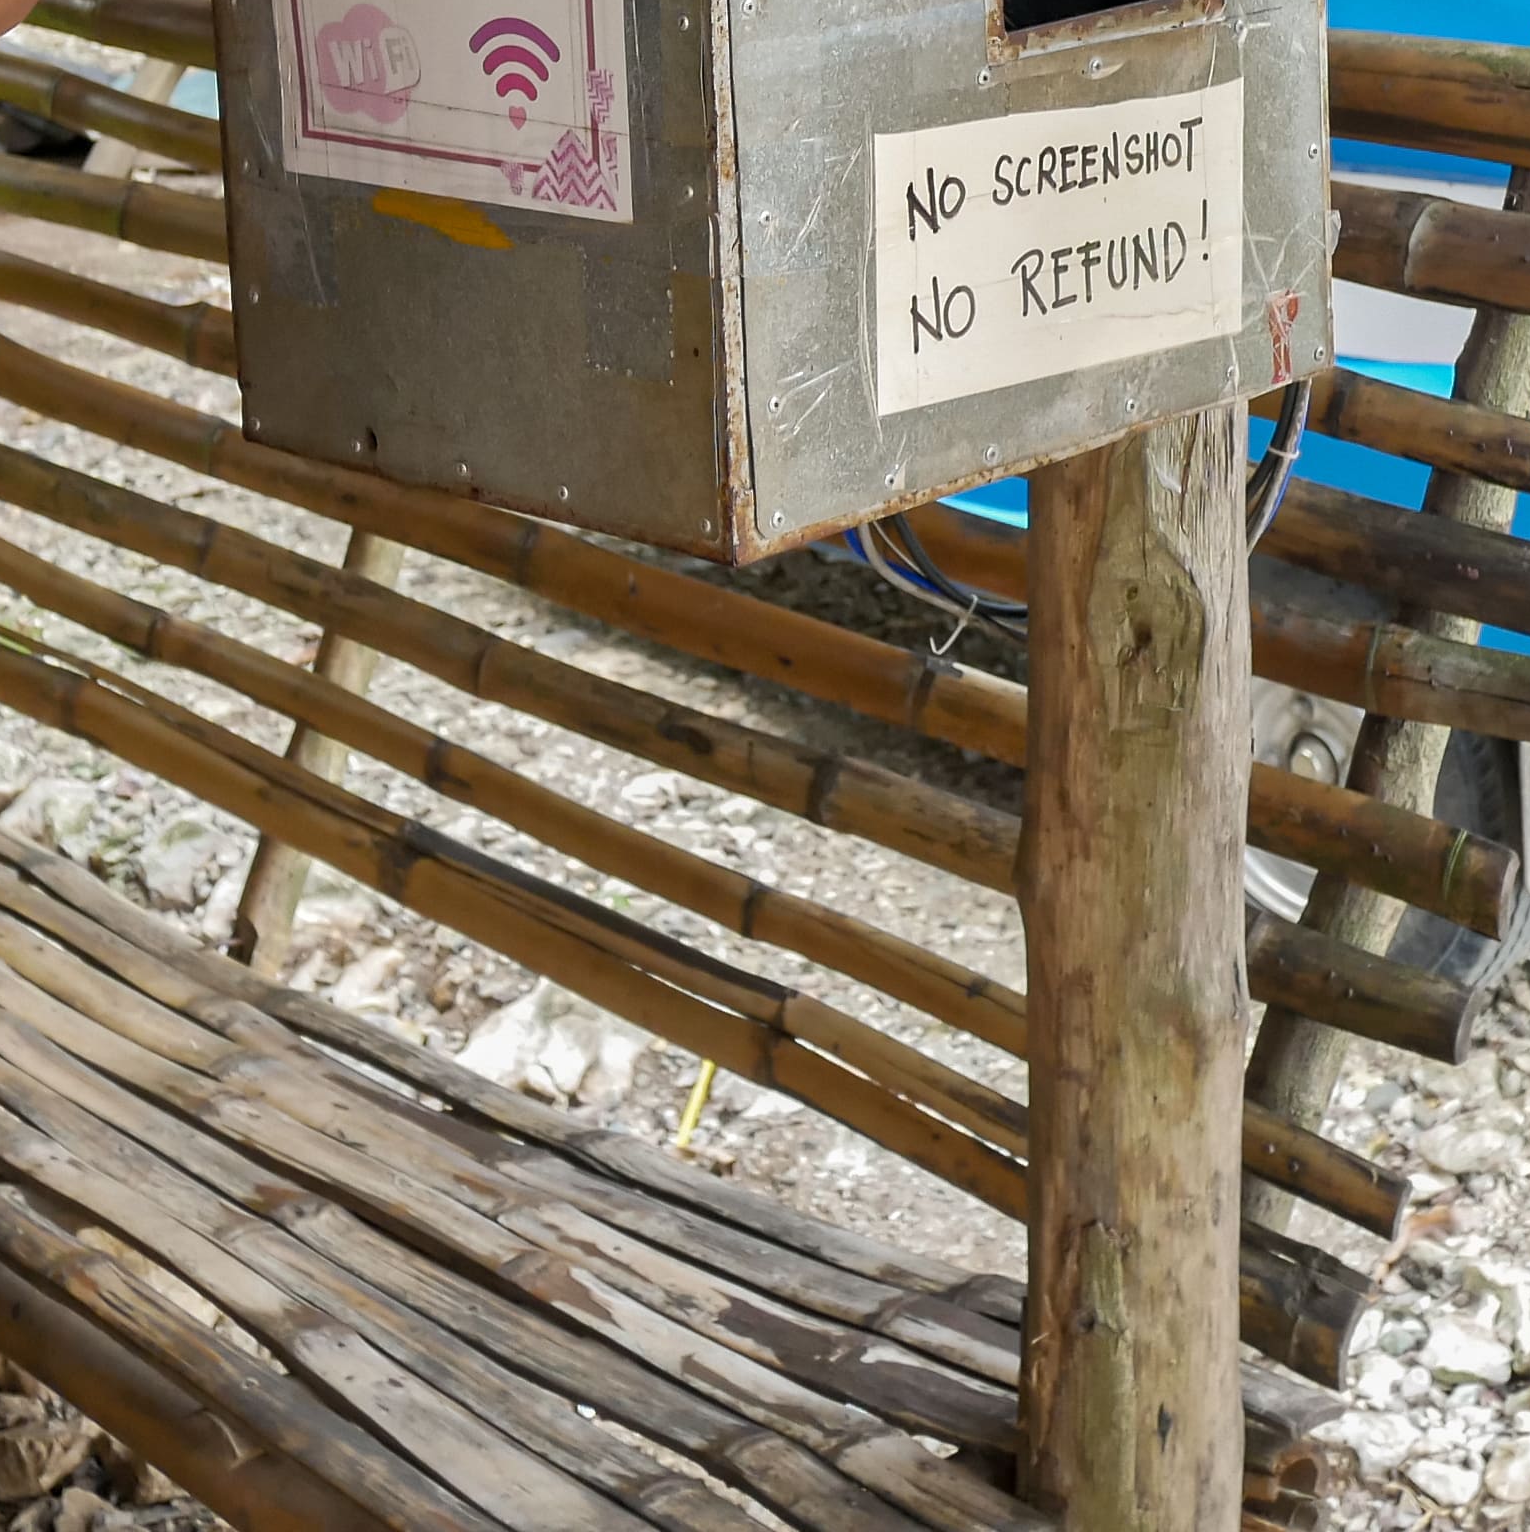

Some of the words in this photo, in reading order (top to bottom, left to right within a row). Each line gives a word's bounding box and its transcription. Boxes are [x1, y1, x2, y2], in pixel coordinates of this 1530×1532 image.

[906, 167, 966, 241] NO
[992, 117, 1203, 206] SCREENSHOT
[910, 276, 976, 354] NO
